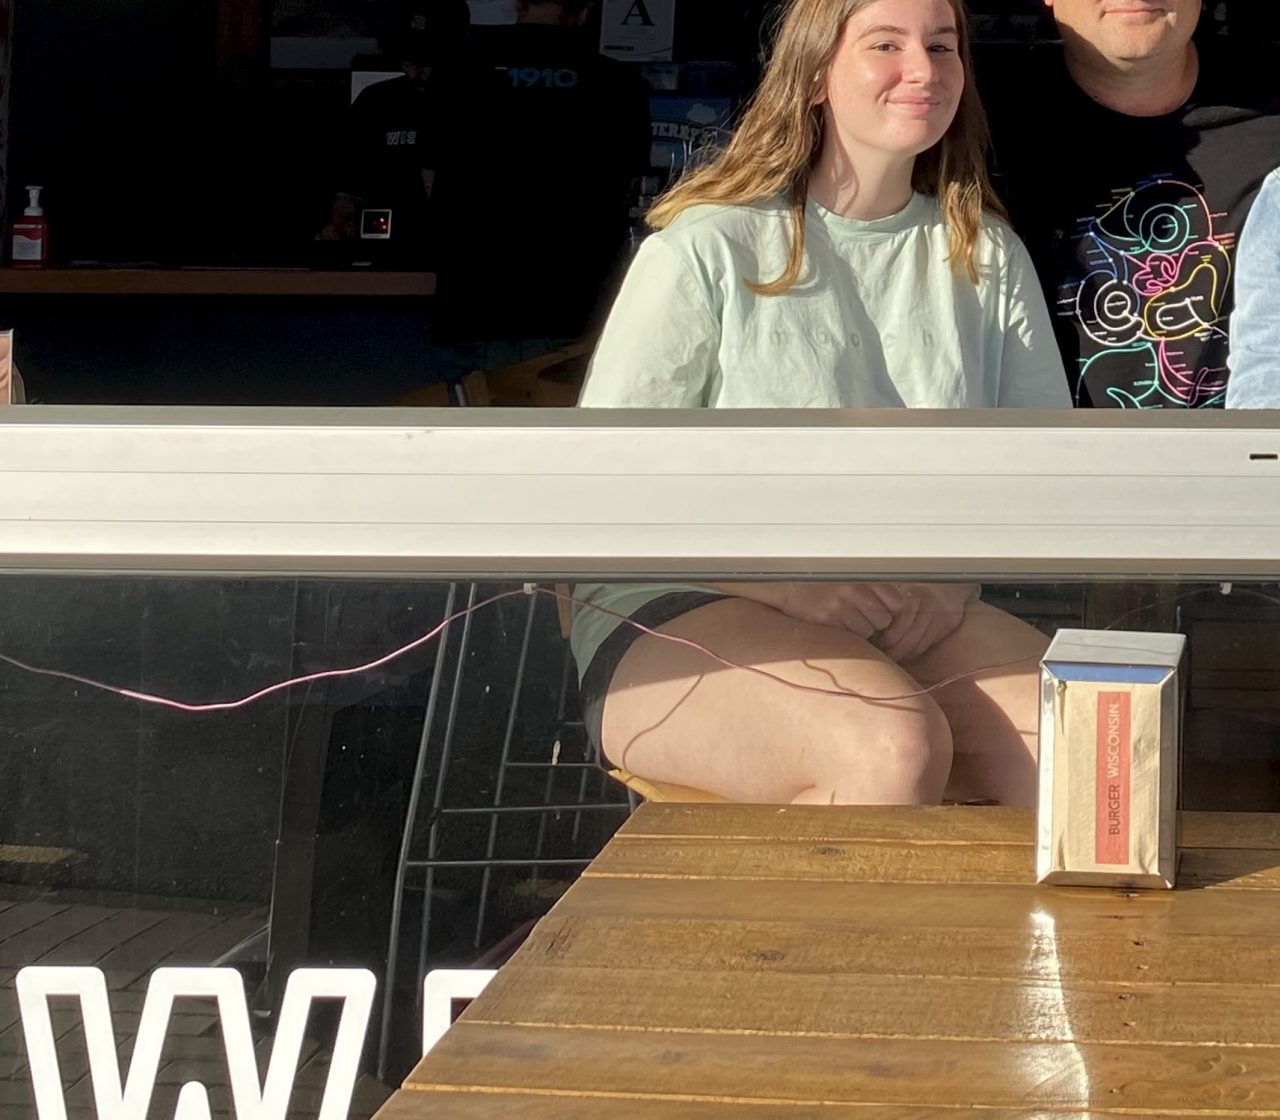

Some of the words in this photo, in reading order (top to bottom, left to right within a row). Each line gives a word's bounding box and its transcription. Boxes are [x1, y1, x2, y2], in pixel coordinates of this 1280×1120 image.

[508, 68, 577, 88] 1910
[1107, 704, 1120, 778] WISCONSIN
[1108, 784, 1121, 836] BURGER
